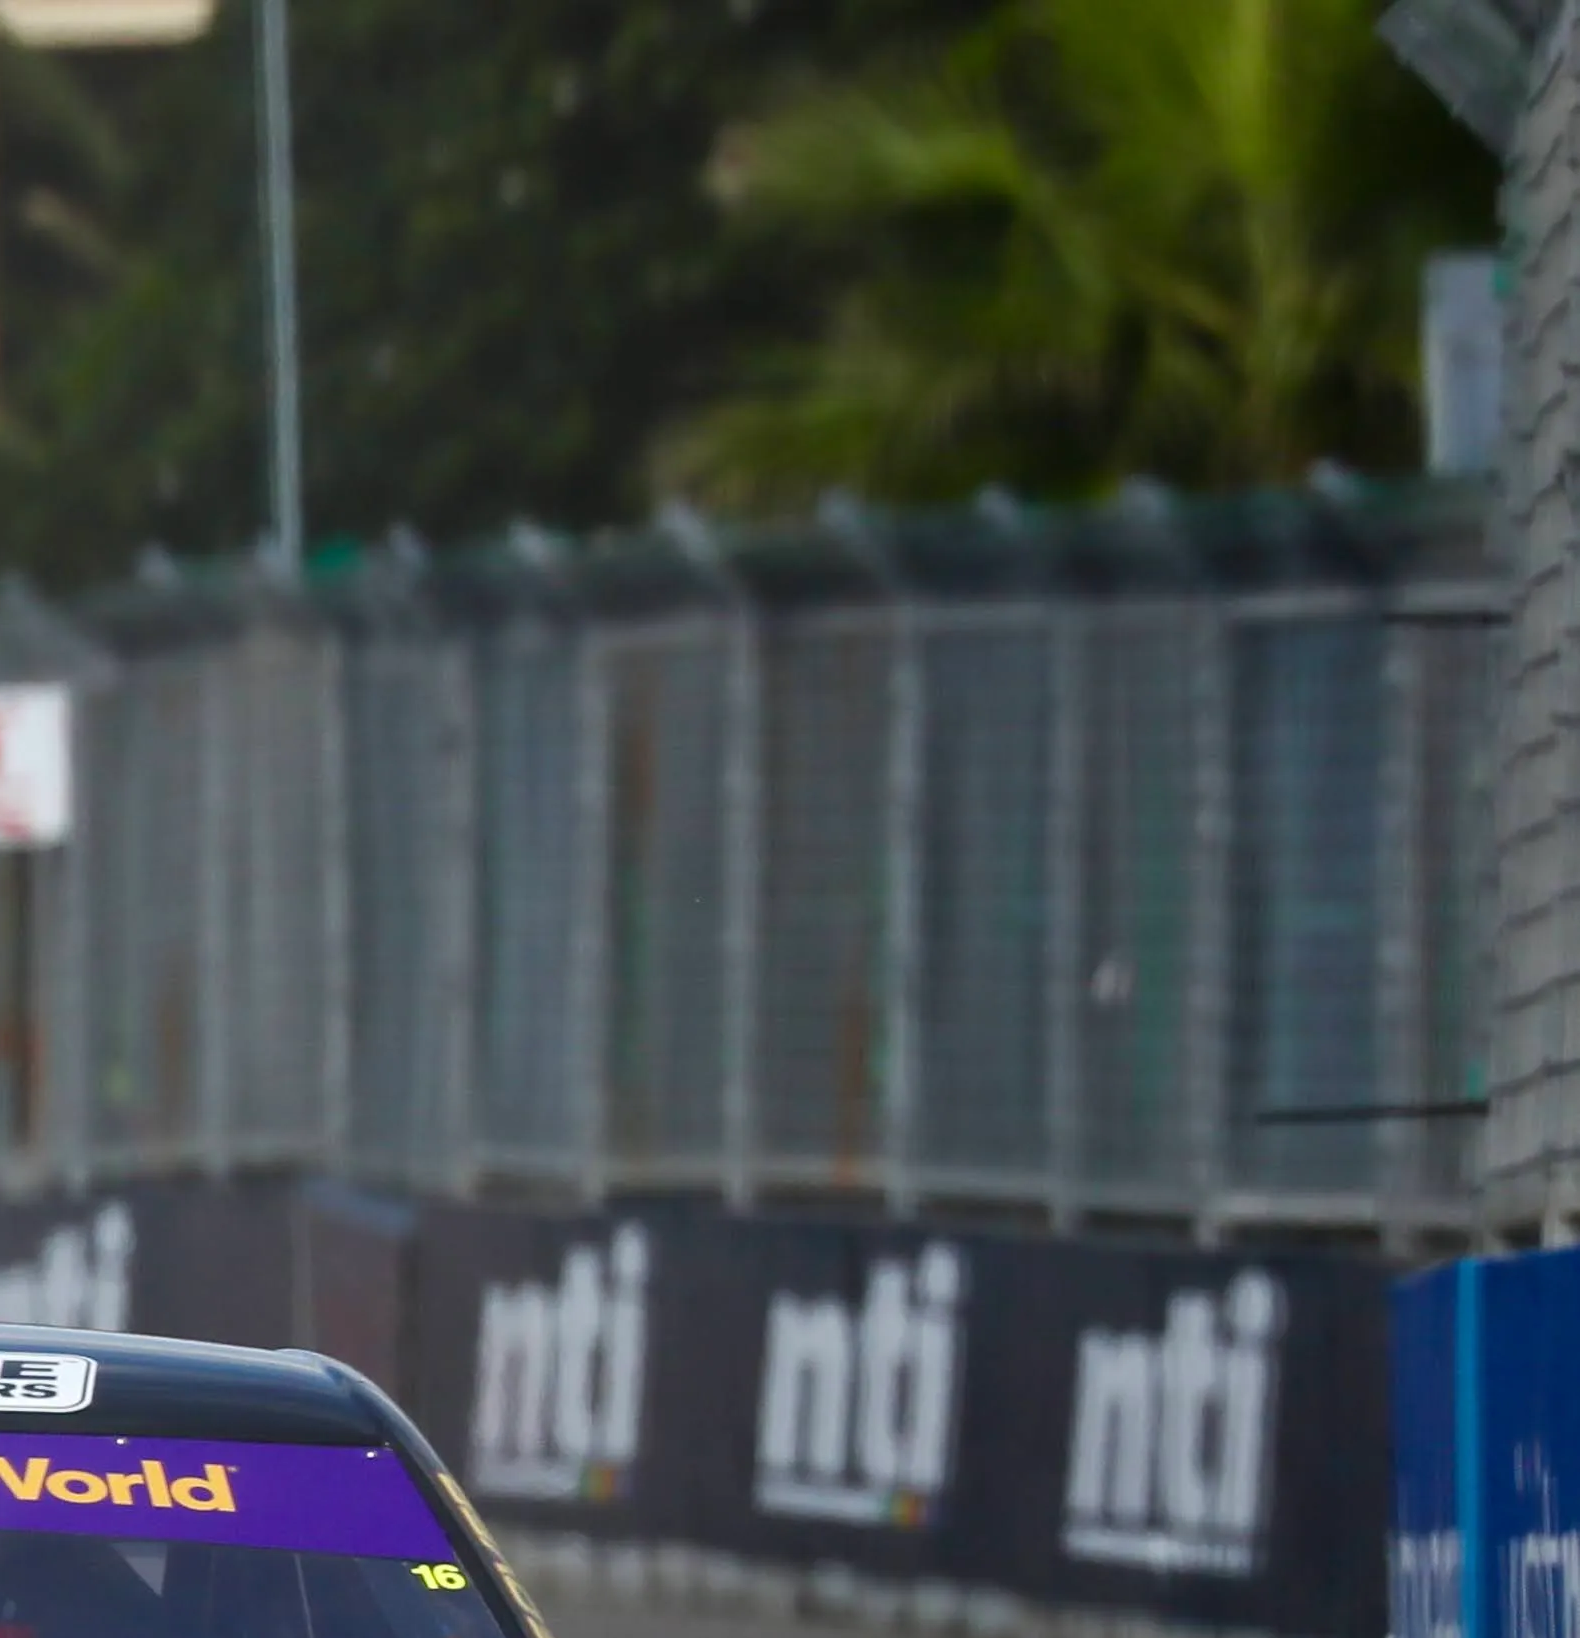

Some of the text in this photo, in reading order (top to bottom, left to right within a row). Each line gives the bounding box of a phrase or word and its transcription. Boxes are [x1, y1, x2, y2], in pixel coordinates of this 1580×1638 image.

[474, 1222, 648, 1464] nti
[758, 1241, 963, 1491] nti
[1068, 1267, 1281, 1531] nti
[409, 1563, 466, 1590] 16
